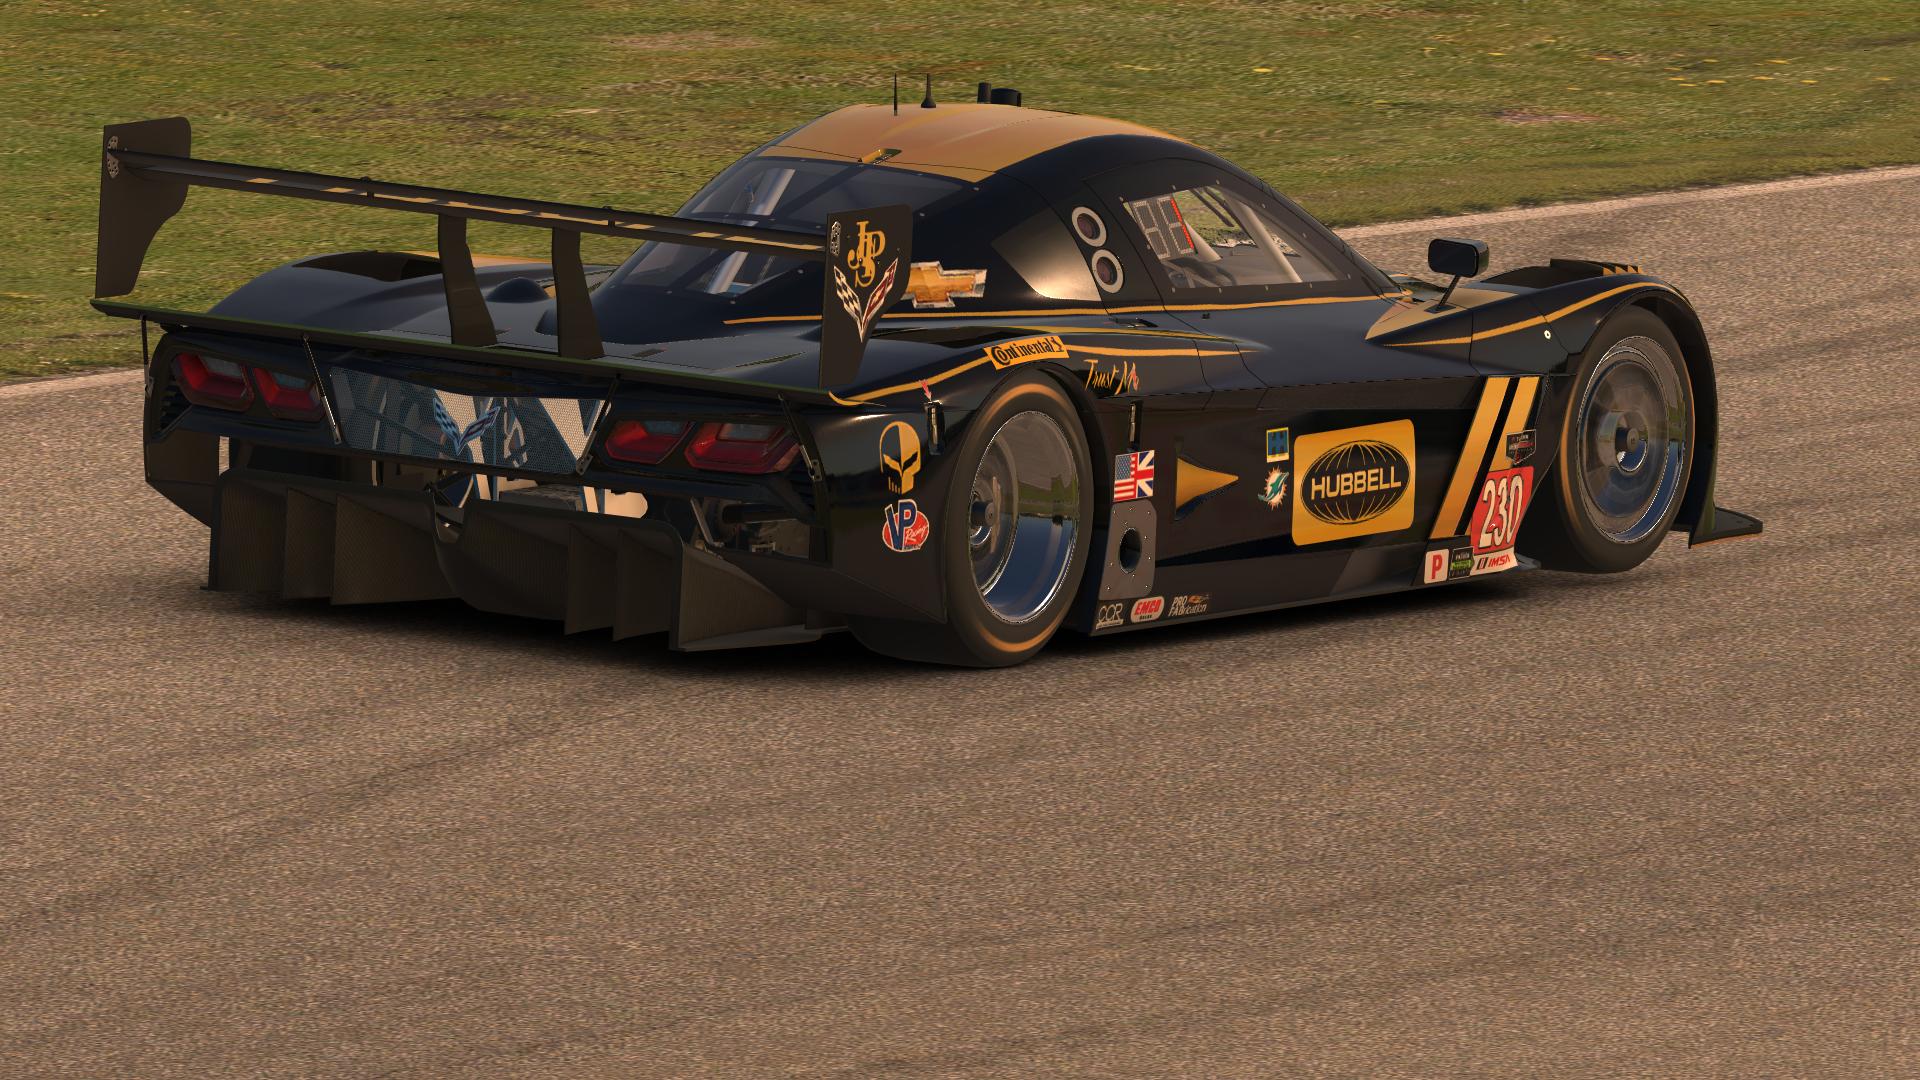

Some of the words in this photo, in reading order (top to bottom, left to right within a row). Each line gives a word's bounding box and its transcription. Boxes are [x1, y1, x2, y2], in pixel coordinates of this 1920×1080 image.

[991, 337, 1055, 365] Continental
[1311, 466, 1401, 500] HUBBELL
[885, 499, 917, 551] VP
[1479, 475, 1522, 549] 230
[1431, 554, 1443, 580] P
[1488, 554, 1511, 568] IMSA
